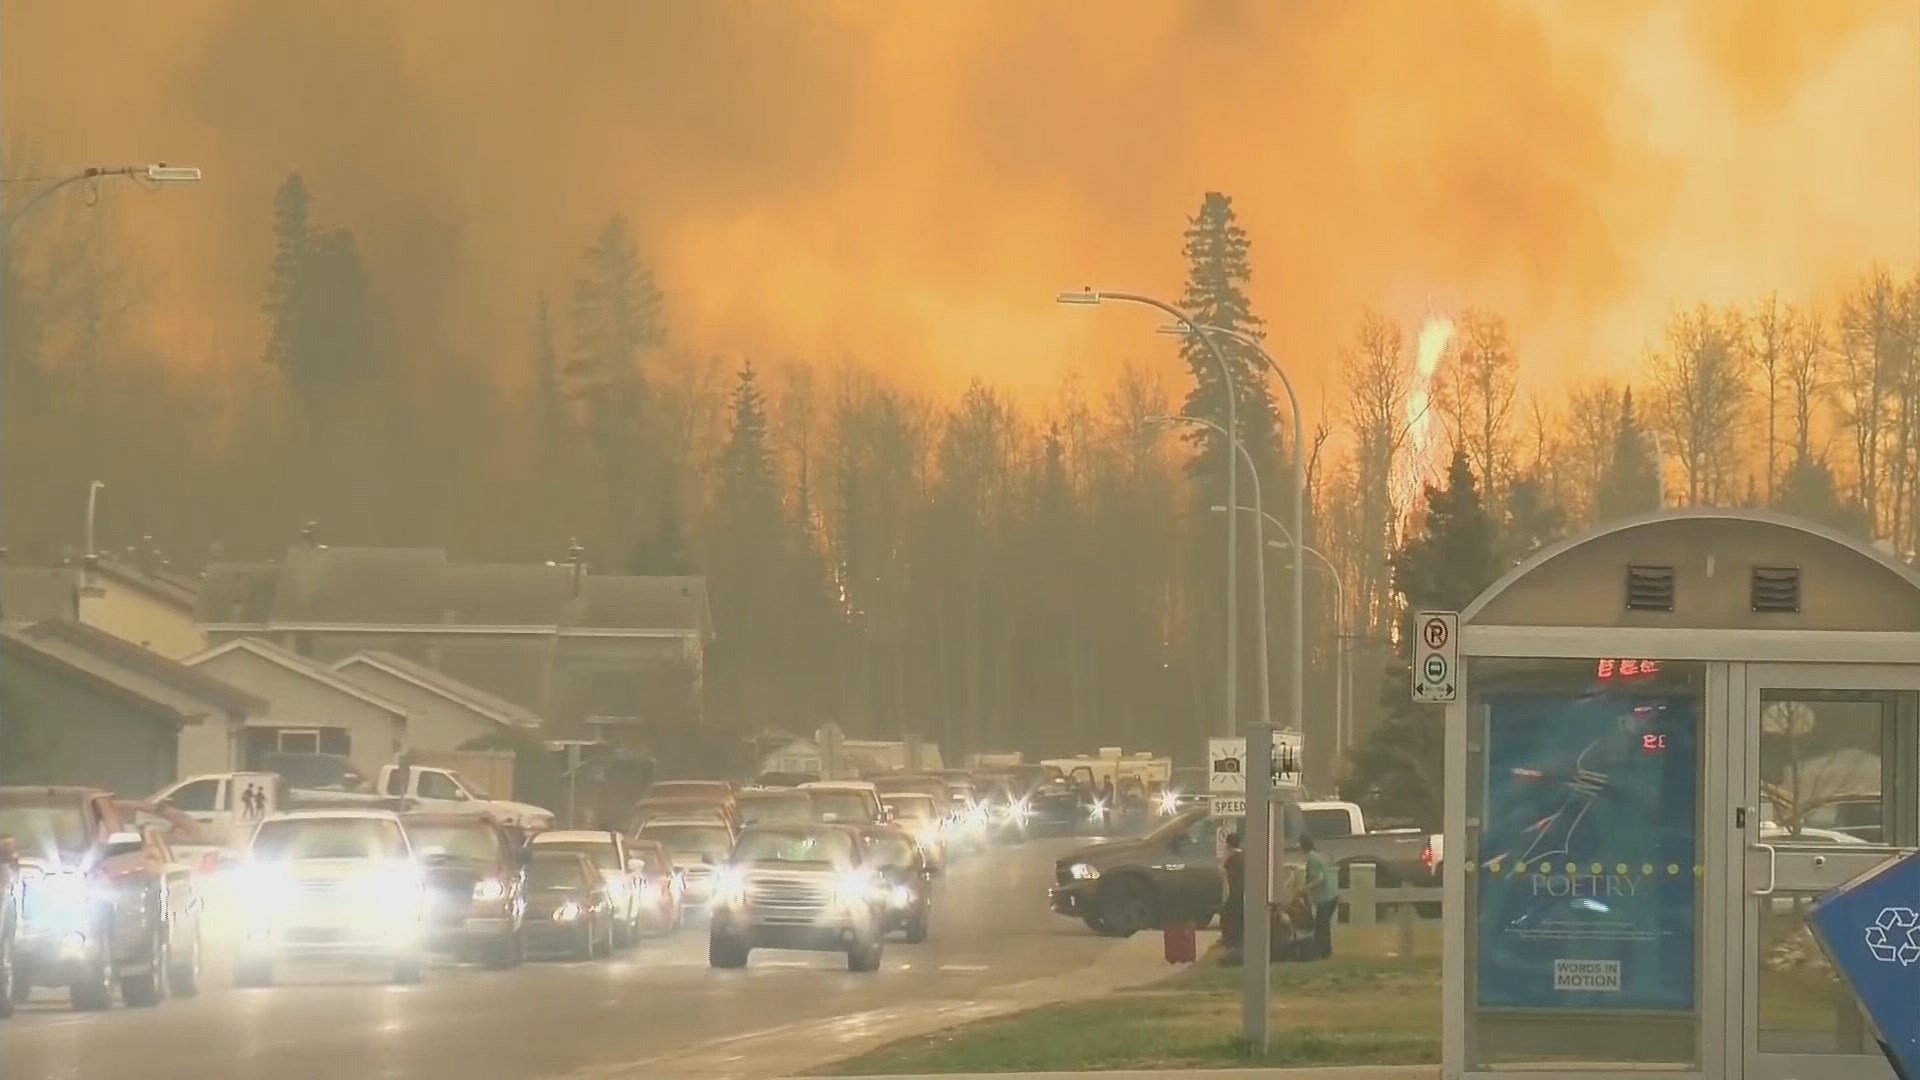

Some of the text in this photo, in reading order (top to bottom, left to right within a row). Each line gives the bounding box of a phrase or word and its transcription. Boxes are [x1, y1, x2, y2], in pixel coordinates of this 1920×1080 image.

[1215, 801, 1246, 812] SPEED
[1530, 873, 1642, 896] POETRY
[1557, 963, 1617, 973] WORDS IN
[1557, 975, 1617, 986] MOTION
